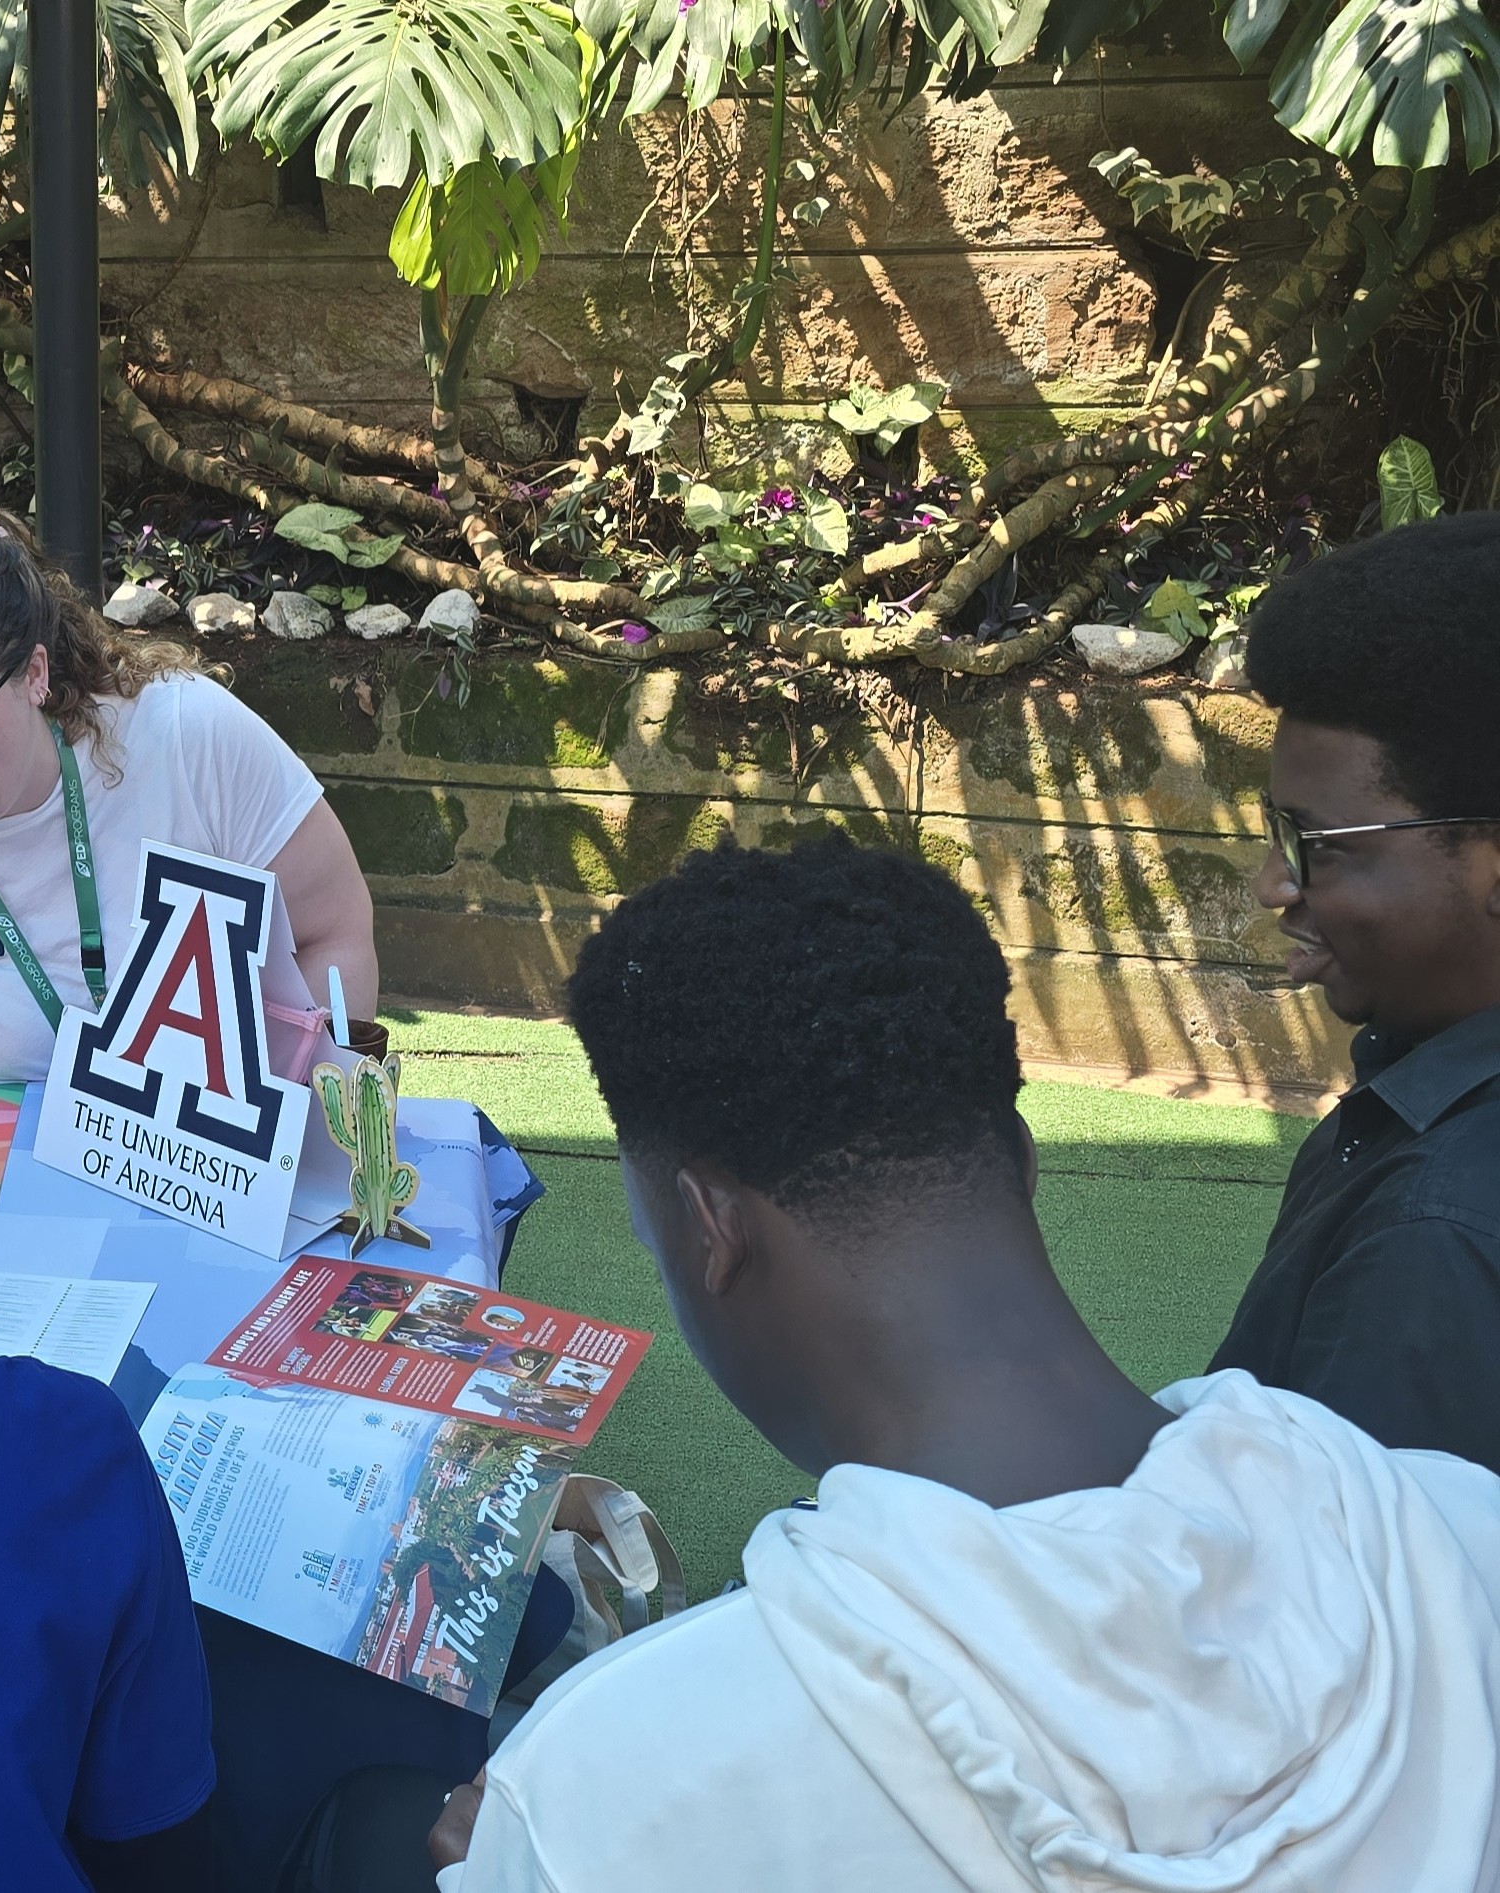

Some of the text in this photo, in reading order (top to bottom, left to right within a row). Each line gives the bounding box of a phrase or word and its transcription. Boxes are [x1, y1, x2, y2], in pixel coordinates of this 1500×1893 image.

[69, 779, 86, 860] EDPROGRAMS
[5, 928, 53, 1001] EDPROGRAMS
[74, 1100, 258, 1196] THE UNIVERSITY
[83, 1149, 225, 1229] OF ARIZONA
[222, 1269, 313, 1362] CAMPUS AND STUDENT LIFE
[153, 1410, 195, 1487] RSITY
[168, 1411, 228, 1514] ARIZONA
[226, 1474, 237, 1483] U
[230, 1461, 242, 1474] OF
[365, 1474, 377, 1489] TOP
[184, 1425, 245, 1550] DO STUDENTS FROM ACROSS
[210, 1482, 234, 1522] CHOOSE
[188, 1559, 204, 1579] THE
[195, 1523, 218, 1558] WORLD
[435, 1445, 542, 1664] This is Tucson
